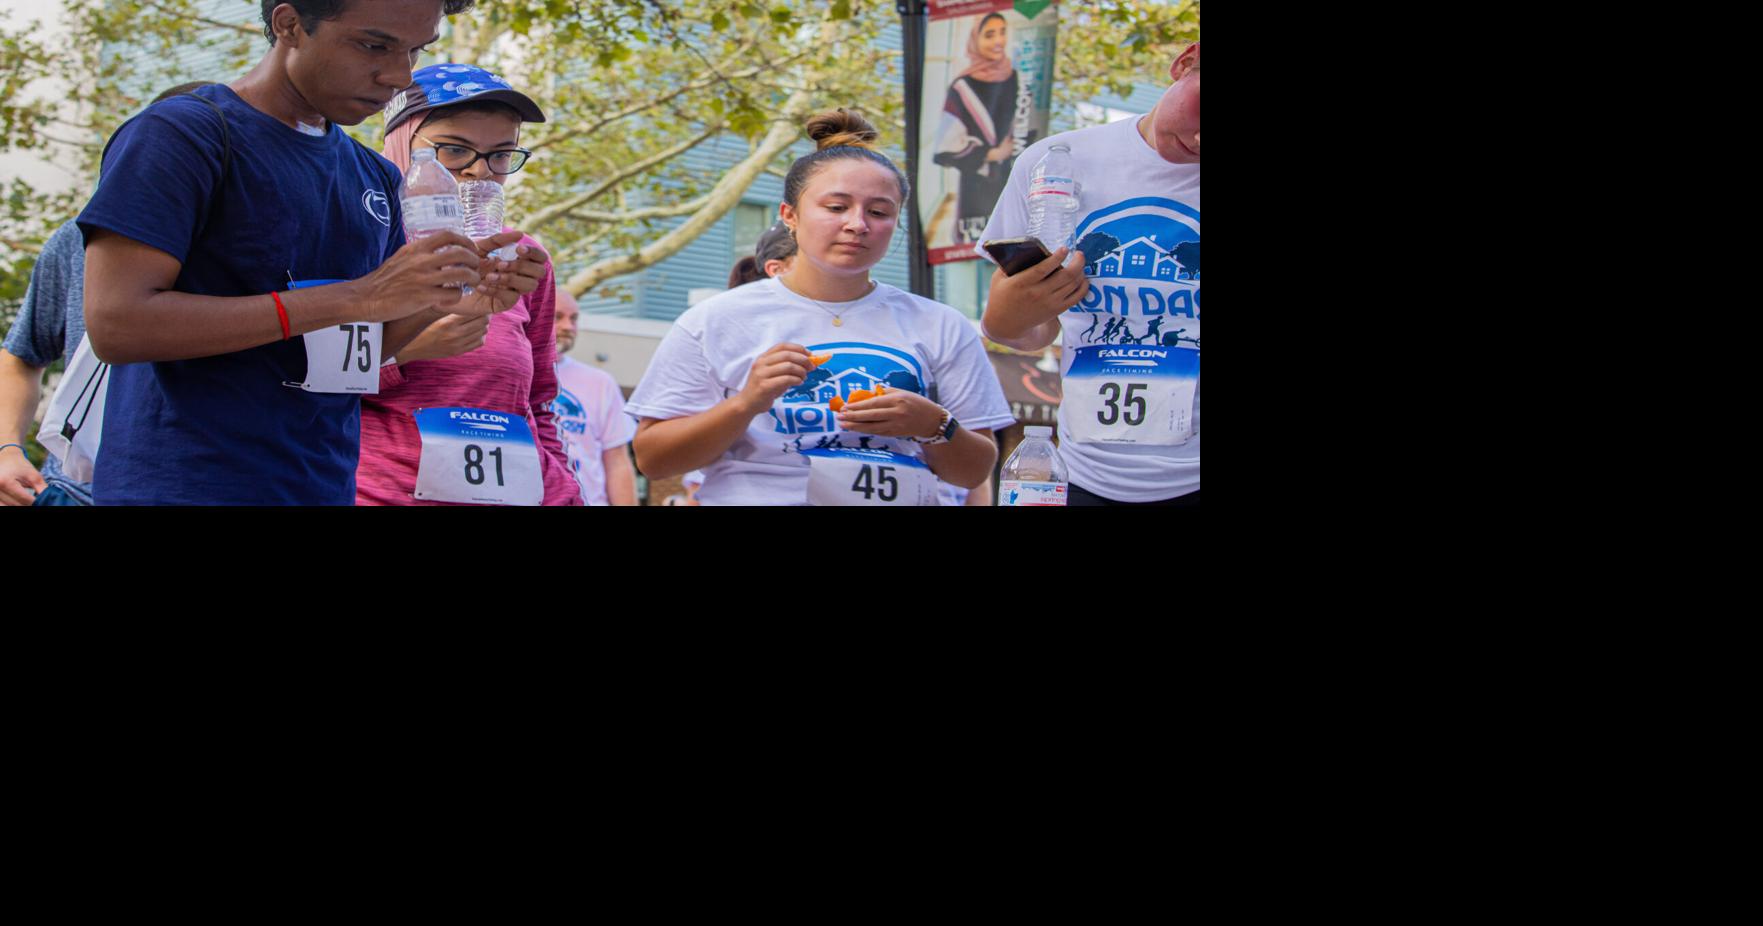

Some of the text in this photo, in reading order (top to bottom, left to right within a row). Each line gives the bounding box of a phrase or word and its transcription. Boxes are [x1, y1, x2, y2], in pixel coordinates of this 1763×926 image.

[1069, 283, 1129, 316] ON
[339, 325, 371, 373] 75
[1098, 349, 1167, 359] FALCON
[450, 411, 510, 424] FALCON
[1097, 382, 1148, 426] 35
[464, 444, 505, 487] 81
[851, 463, 898, 502] 45
